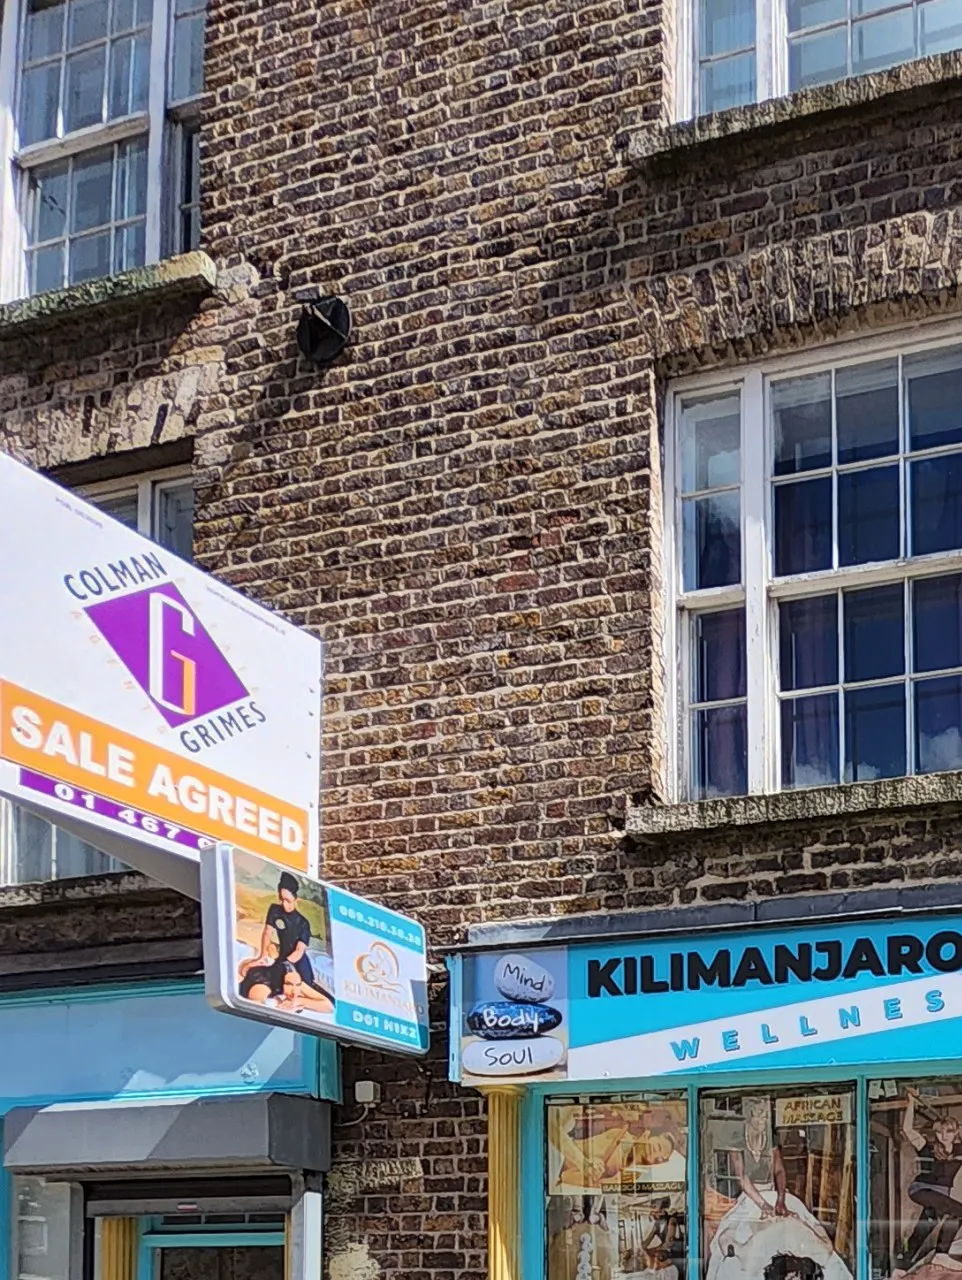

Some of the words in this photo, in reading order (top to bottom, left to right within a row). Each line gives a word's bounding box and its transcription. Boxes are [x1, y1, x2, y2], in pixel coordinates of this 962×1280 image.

[64, 552, 168, 600] COLMAN
[180, 701, 268, 753] GRIMES
[10, 705, 136, 788] SALE
[147, 763, 304, 853] AGREED
[54, 783, 96, 810] 01
[117, 810, 182, 841] 467
[502, 962, 546, 992] Mind
[483, 1007, 539, 1033] Body
[484, 1046, 533, 1066] Soul
[784, 1098, 842, 1111] AFRICAN
